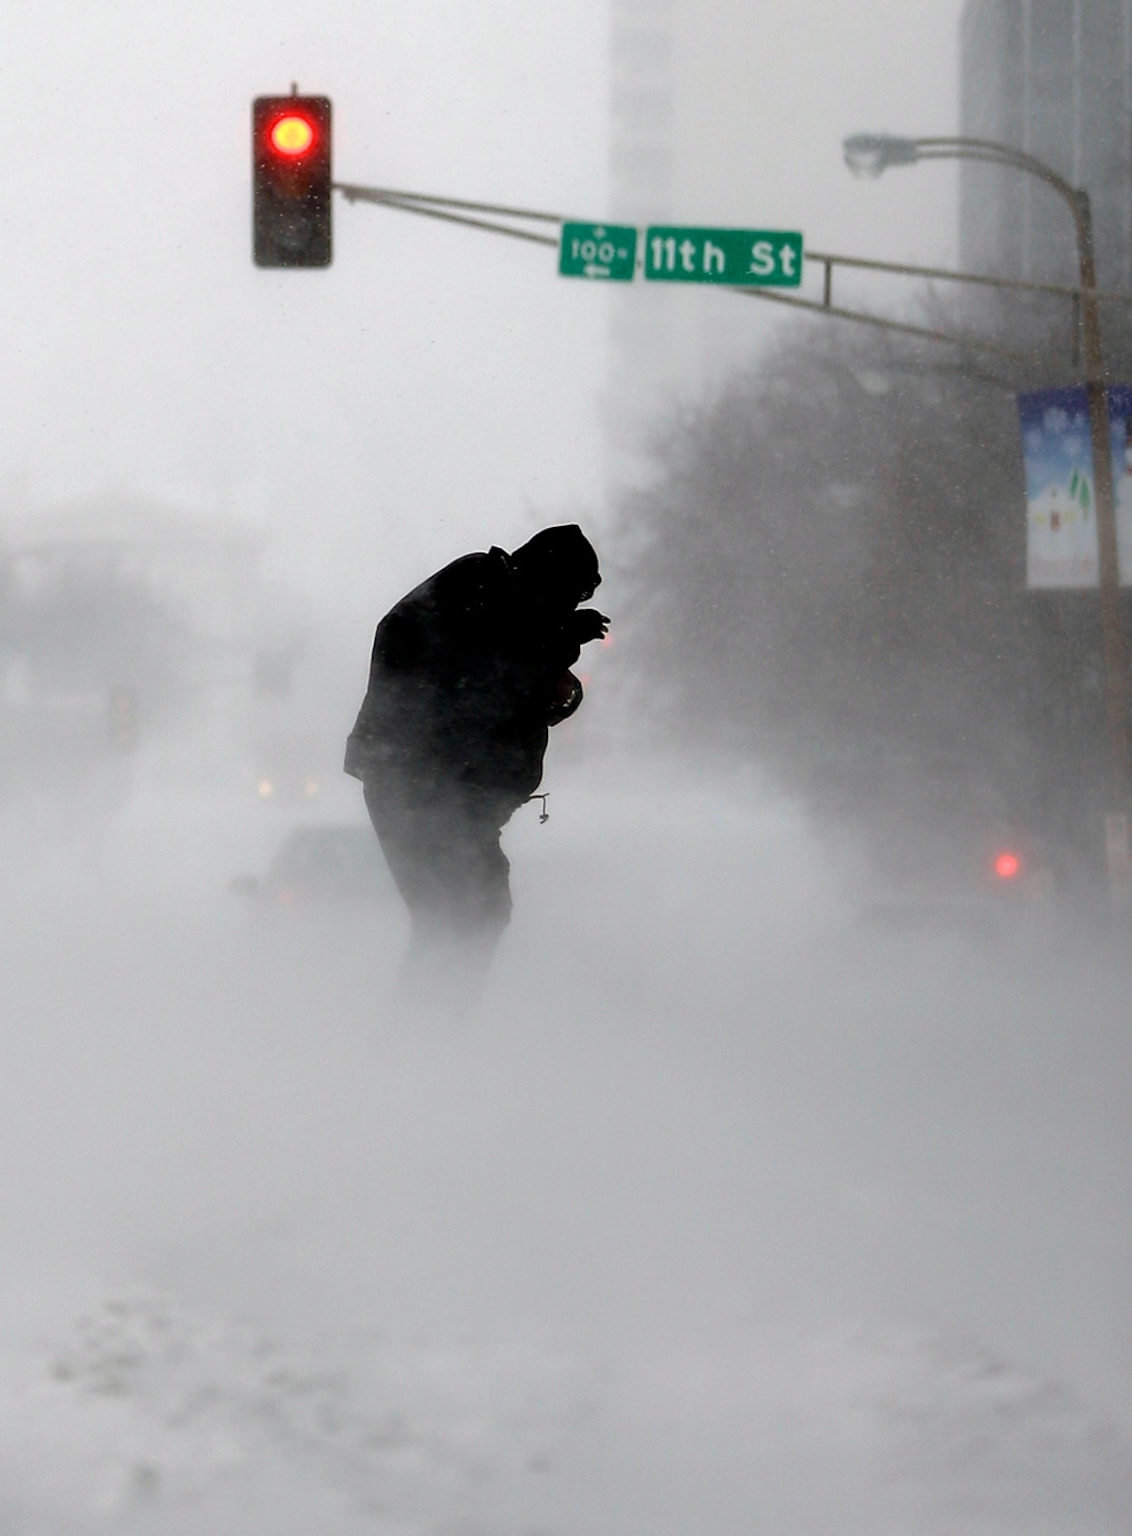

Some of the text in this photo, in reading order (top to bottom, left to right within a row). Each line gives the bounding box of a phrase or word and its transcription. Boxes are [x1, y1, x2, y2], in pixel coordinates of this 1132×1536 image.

[571, 238, 615, 263] 100
[651, 236, 796, 277] 11th St
